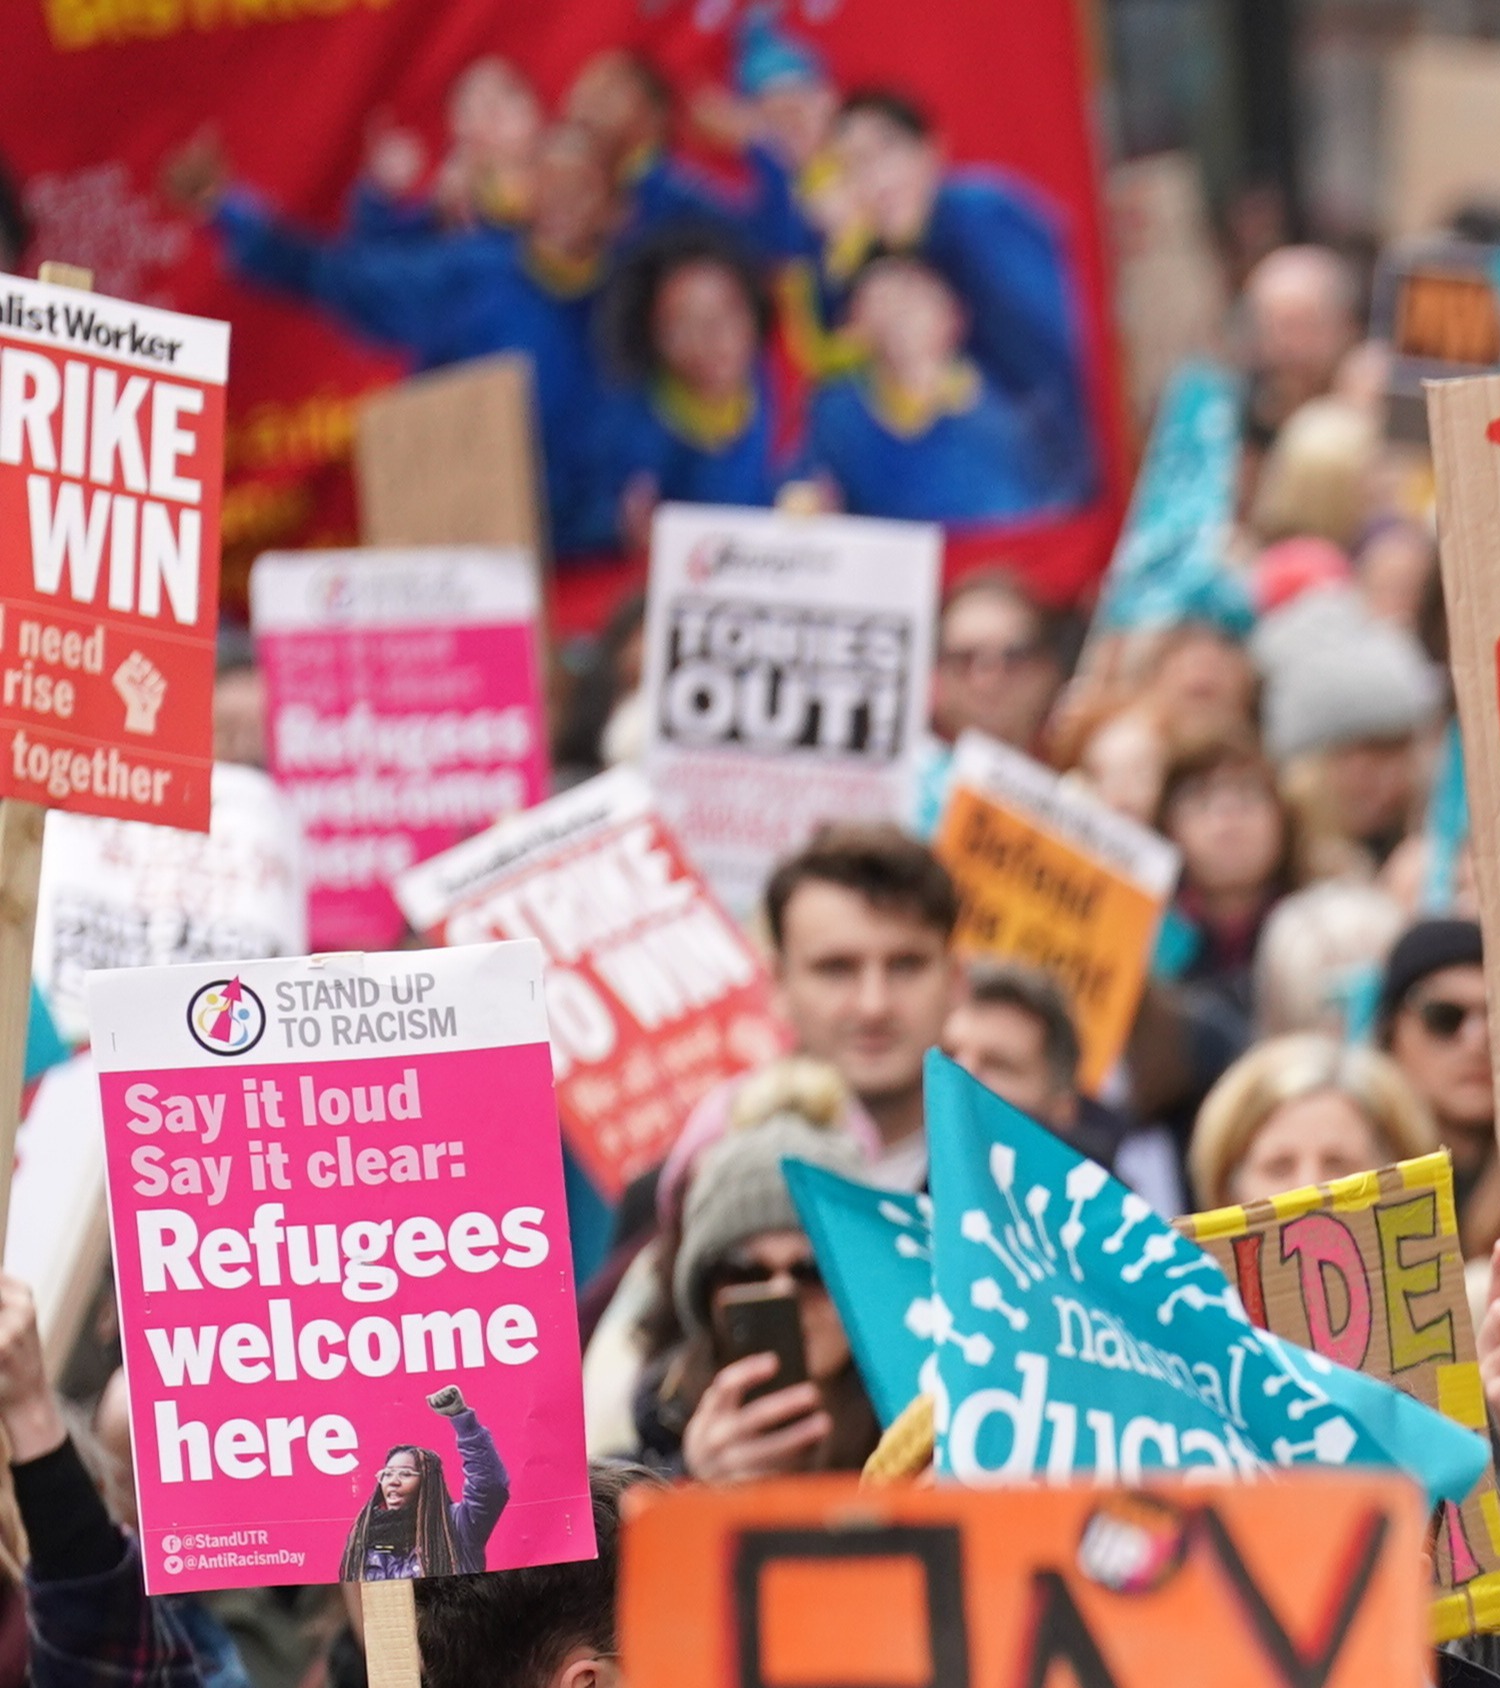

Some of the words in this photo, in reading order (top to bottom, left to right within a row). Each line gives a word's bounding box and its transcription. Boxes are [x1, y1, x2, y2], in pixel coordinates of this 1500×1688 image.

[63, 302, 183, 365] Worker
[0, 346, 204, 504] RIKE
[26, 474, 202, 626] WIN
[19, 619, 105, 672] need
[672, 604, 906, 670] TORIES
[3, 663, 75, 717] rise
[666, 660, 900, 757] OUT!
[11, 728, 171, 806] together
[274, 703, 530, 775] Refugees
[275, 978, 379, 1013] STAND
[390, 973, 436, 1005] UP
[279, 1016, 323, 1049] TO
[331, 1007, 458, 1046] RACISM
[123, 1083, 226, 1144] Say
[242, 1077, 284, 1129] it
[299, 1067, 422, 1127] loud
[130, 1145, 232, 1206] Say
[249, 1140, 291, 1192] it
[306, 1134, 467, 1187] clear:
[135, 1201, 550, 1304] Refugees
[143, 1297, 540, 1388] welcome
[153, 1398, 360, 1484] here
[183, 1529, 269, 1551] @StandUTR
[184, 1549, 306, 1571] @AntiRacismDay
